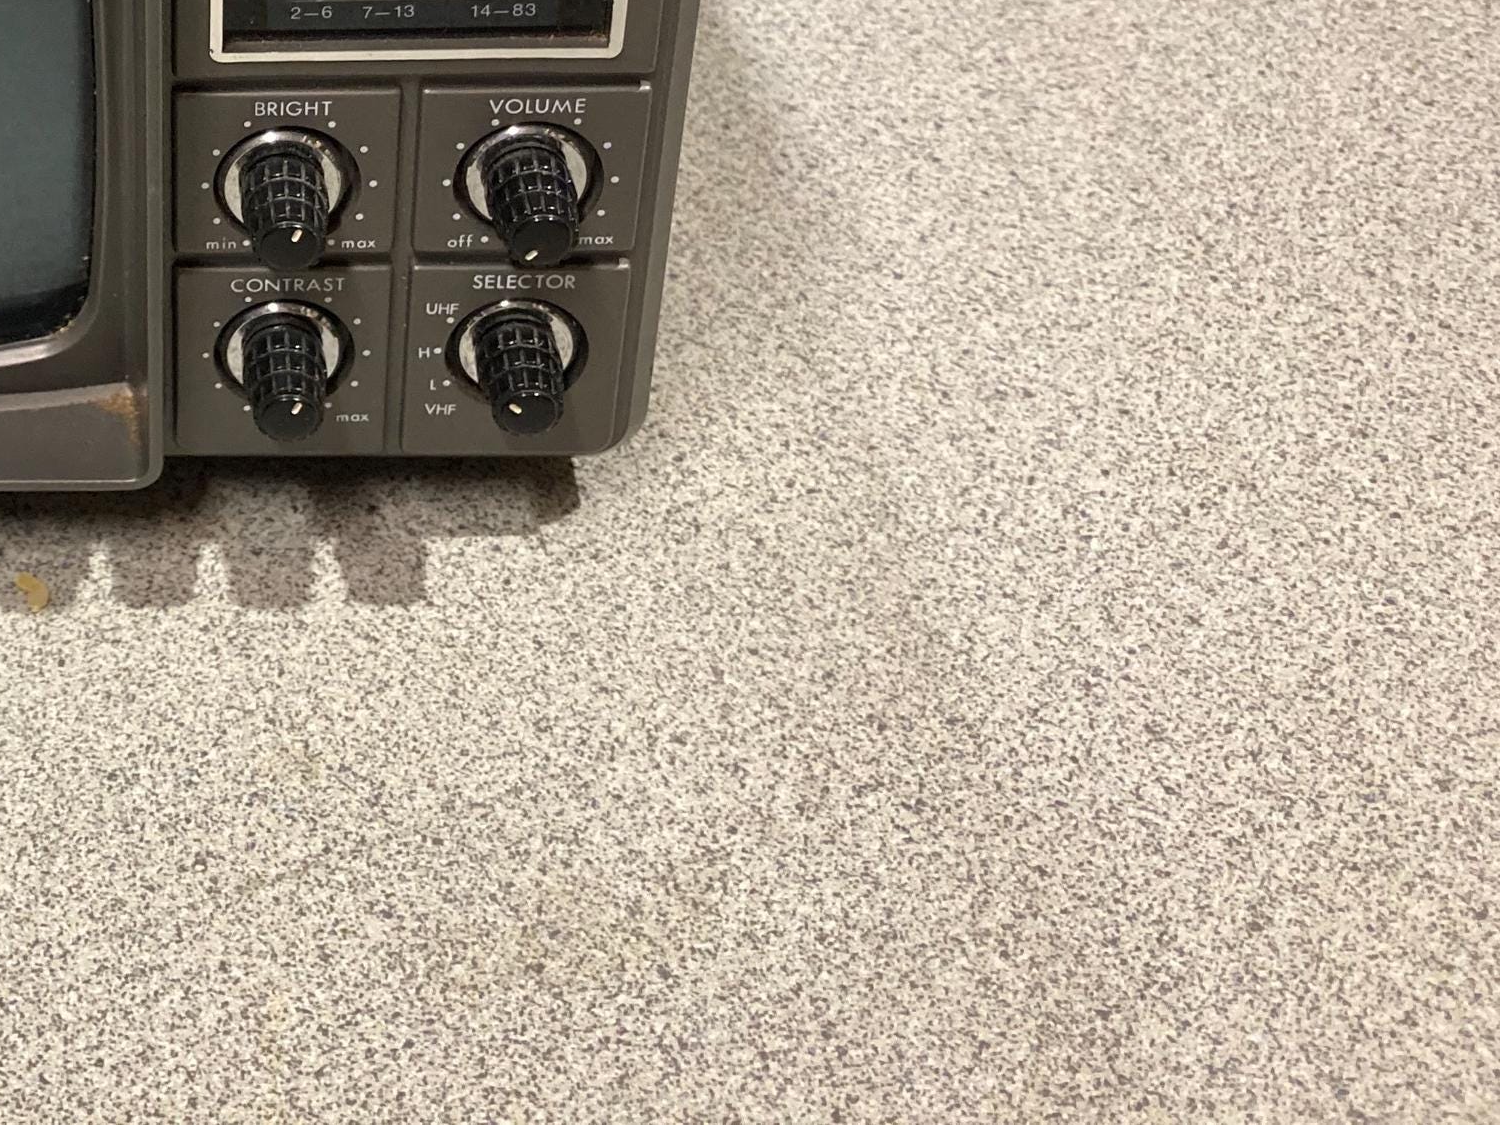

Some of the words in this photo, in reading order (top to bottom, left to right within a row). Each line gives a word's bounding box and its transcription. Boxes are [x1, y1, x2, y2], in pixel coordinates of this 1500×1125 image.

[362, 4, 415, 19] 7-13
[470, 2, 536, 18] 14-83
[254, 100, 332, 117] BRIGHT
[489, 98, 587, 115] VOLUME
[206, 237, 237, 250] min
[341, 238, 376, 250] max
[447, 233, 474, 249] off
[578, 233, 614, 246] max
[230, 277, 345, 293] CONTRAST
[472, 274, 576, 291] SELECTOR
[426, 302, 460, 317] UHF
[418, 347, 430, 360] H
[430, 380, 437, 391] L
[425, 402, 457, 417] VHF
[336, 411, 370, 424] max
